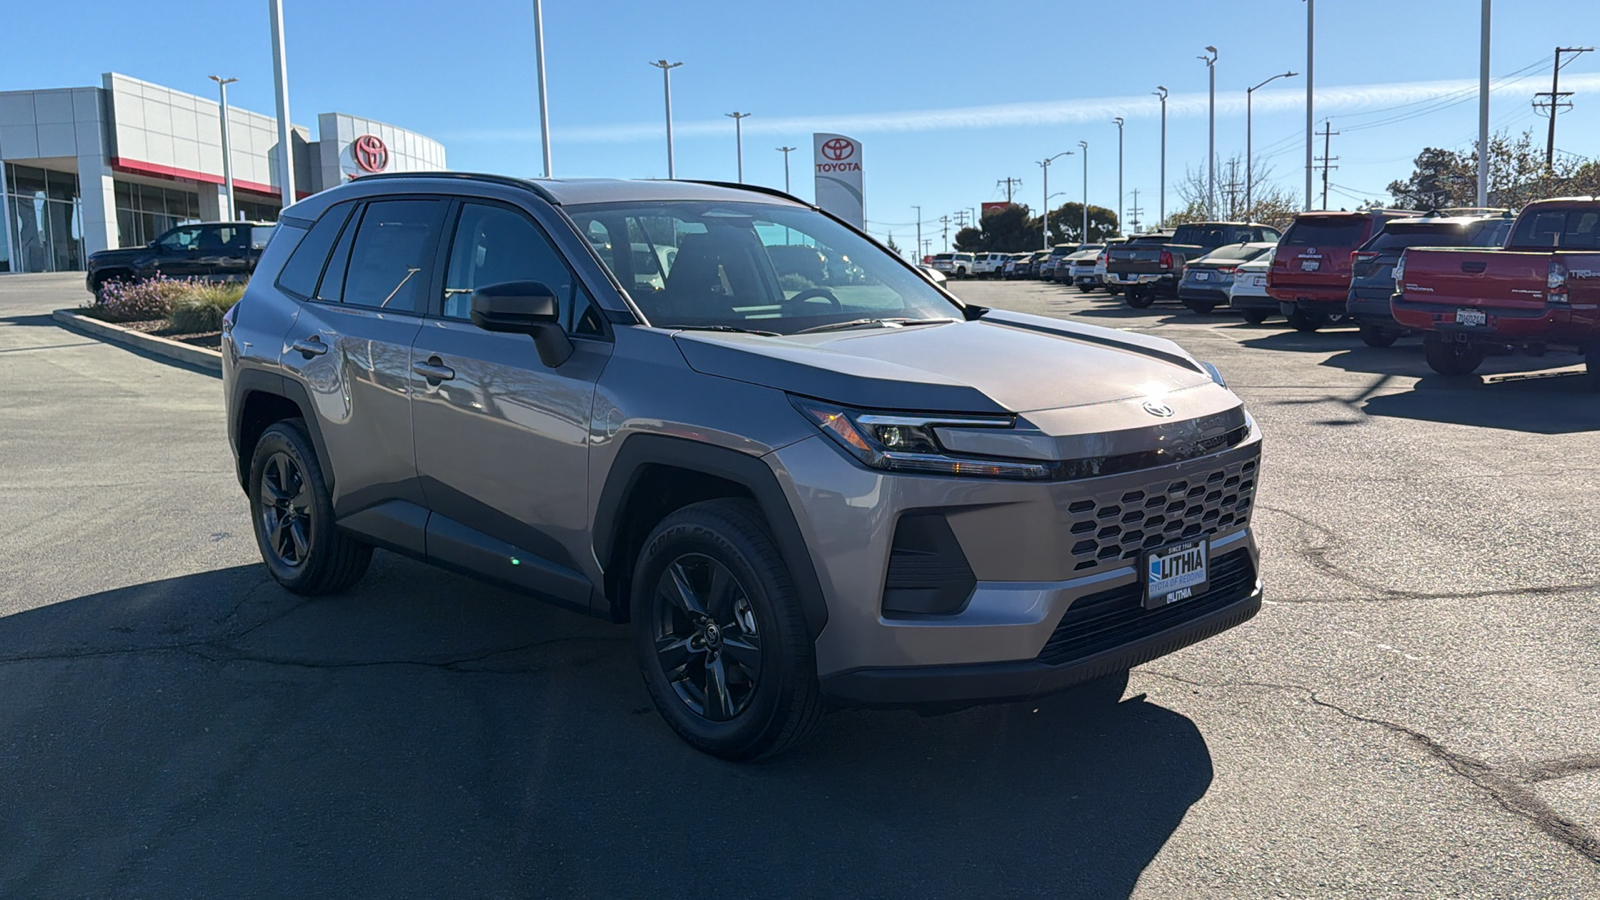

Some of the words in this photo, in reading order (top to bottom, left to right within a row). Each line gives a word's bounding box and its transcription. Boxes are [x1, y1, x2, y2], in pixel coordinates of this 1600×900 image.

[816, 162, 861, 173] TOYOTA
[1168, 544, 1181, 554] SINCE
[1161, 549, 1203, 580] LITHIA
[1150, 581, 1169, 593] OYOTA
[1170, 577, 1178, 587] OF
[1179, 569, 1204, 584] REDDING
[1172, 587, 1192, 602] LITHIA
